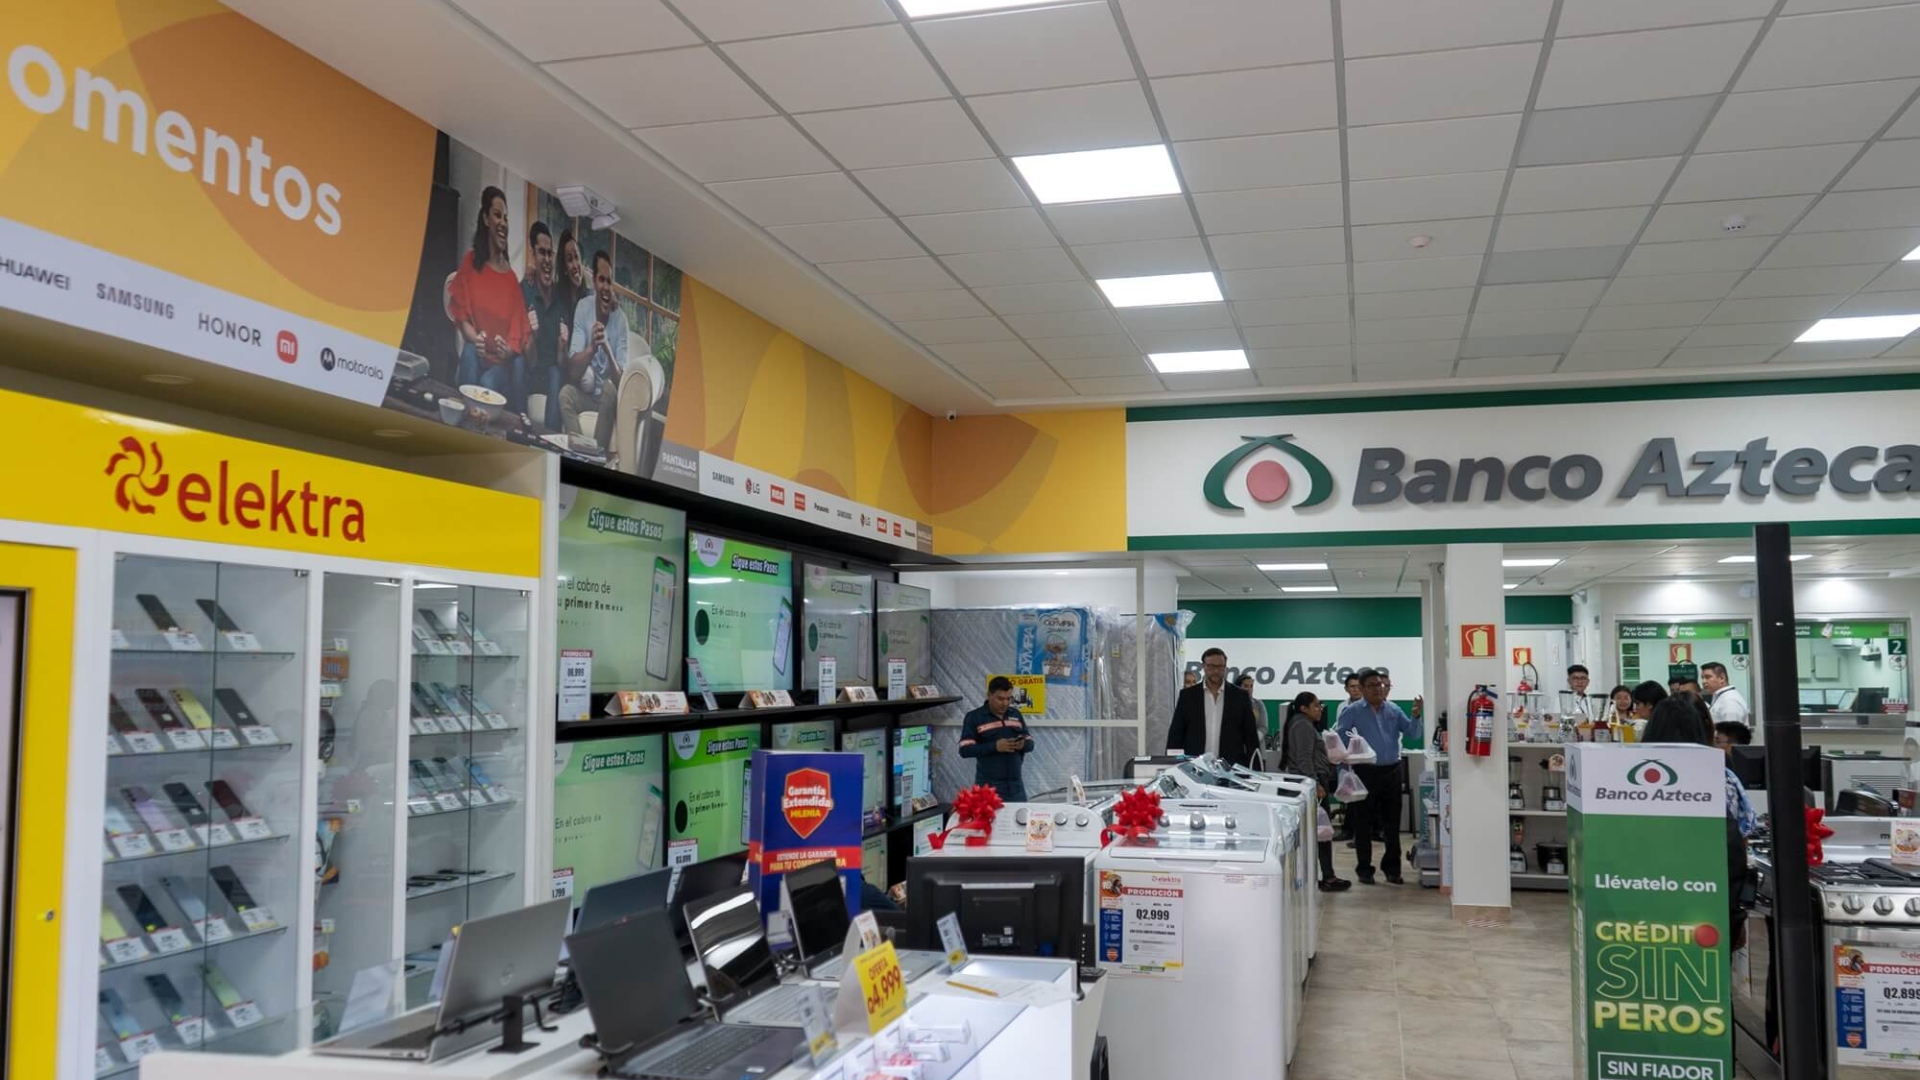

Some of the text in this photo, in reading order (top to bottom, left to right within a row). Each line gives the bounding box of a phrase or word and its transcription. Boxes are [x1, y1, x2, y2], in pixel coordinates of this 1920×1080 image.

[7, 44, 342, 236] omentos
[0, 256, 70, 291] HUAWEI
[96, 283, 175, 320] SAMSUNG
[198, 313, 262, 347] HONOR
[337, 356, 384, 381] motorola
[662, 452, 698, 472] PANTALLAS
[1352, 436, 1920, 507] Banco Azteca
[712, 471, 735, 486] SAMSUNG
[176, 460, 366, 543] elektra
[590, 508, 662, 538] Sigue estos Pasos
[732, 554, 748, 572] Sigue
[763, 560, 779, 575] Pasos
[576, 577, 600, 593] cobro
[601, 580, 612, 595] de
[564, 596, 593, 611] primer
[1736, 640, 1745, 654] 1
[1892, 640, 1903, 654] 2
[1018, 677, 1044, 686] GRATIS
[1185, 661, 1390, 685] Bnco Azte
[583, 750, 644, 774] Sigue estos Pasos
[788, 785, 826, 796] Garantía
[1595, 787, 1648, 801] Banco
[1651, 788, 1712, 802] Azteca
[782, 796, 831, 809] Extendida
[555, 817, 564, 830] En
[573, 814, 592, 827] cobro
[594, 812, 602, 822] de
[790, 809, 821, 819] MILENIA
[1158, 875, 1182, 883] elektra
[1594, 873, 1717, 893] Llévatelo con
[1127, 888, 1179, 897] PROMOCIÓN
[1595, 920, 1720, 947] CRÉDITO
[868, 956, 889, 981] OFERTA
[1596, 943, 1720, 1004] SIN
[1594, 999, 1726, 1037] PEROS
[1607, 1060, 1714, 1080] SIN FIADOR
